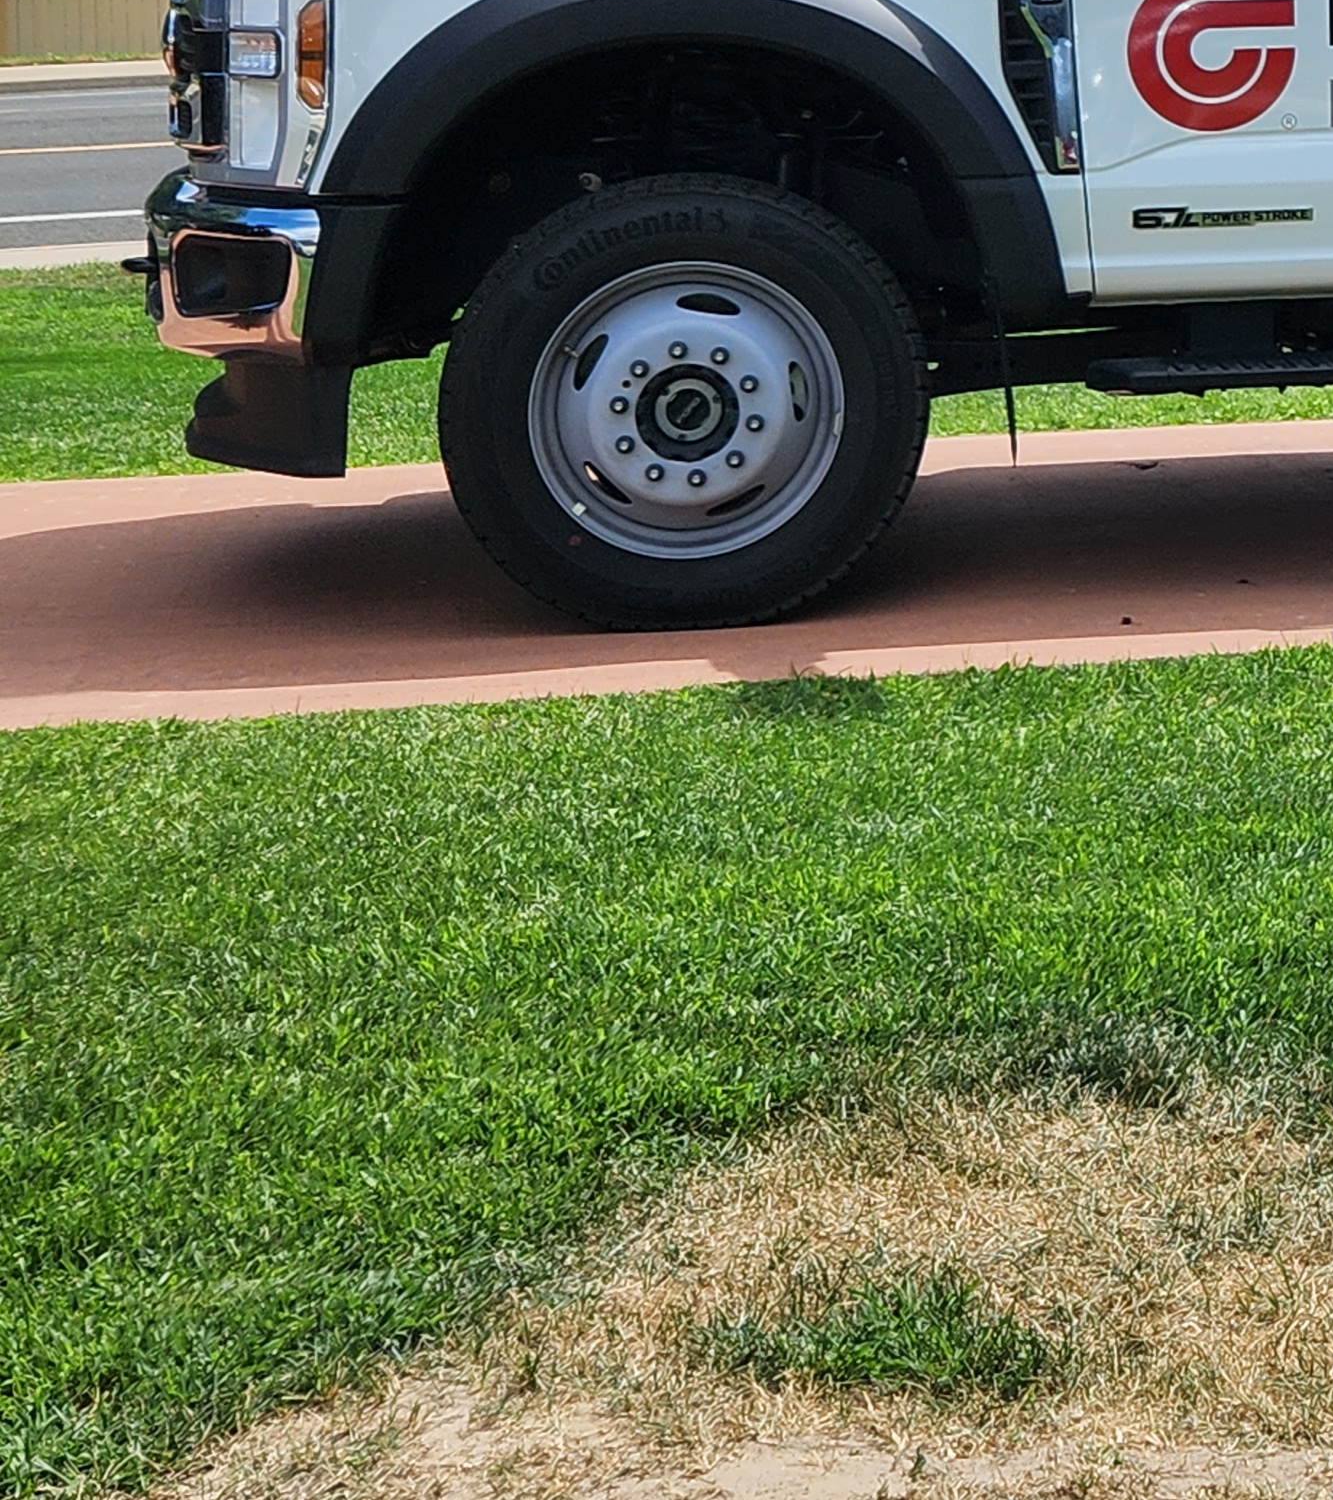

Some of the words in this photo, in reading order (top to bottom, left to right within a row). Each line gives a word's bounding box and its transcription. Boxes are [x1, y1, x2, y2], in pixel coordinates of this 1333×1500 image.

[1132, 206, 1200, 229] 6.7L
[1201, 210, 1252, 224] POWER
[1253, 208, 1310, 222] STROKE
